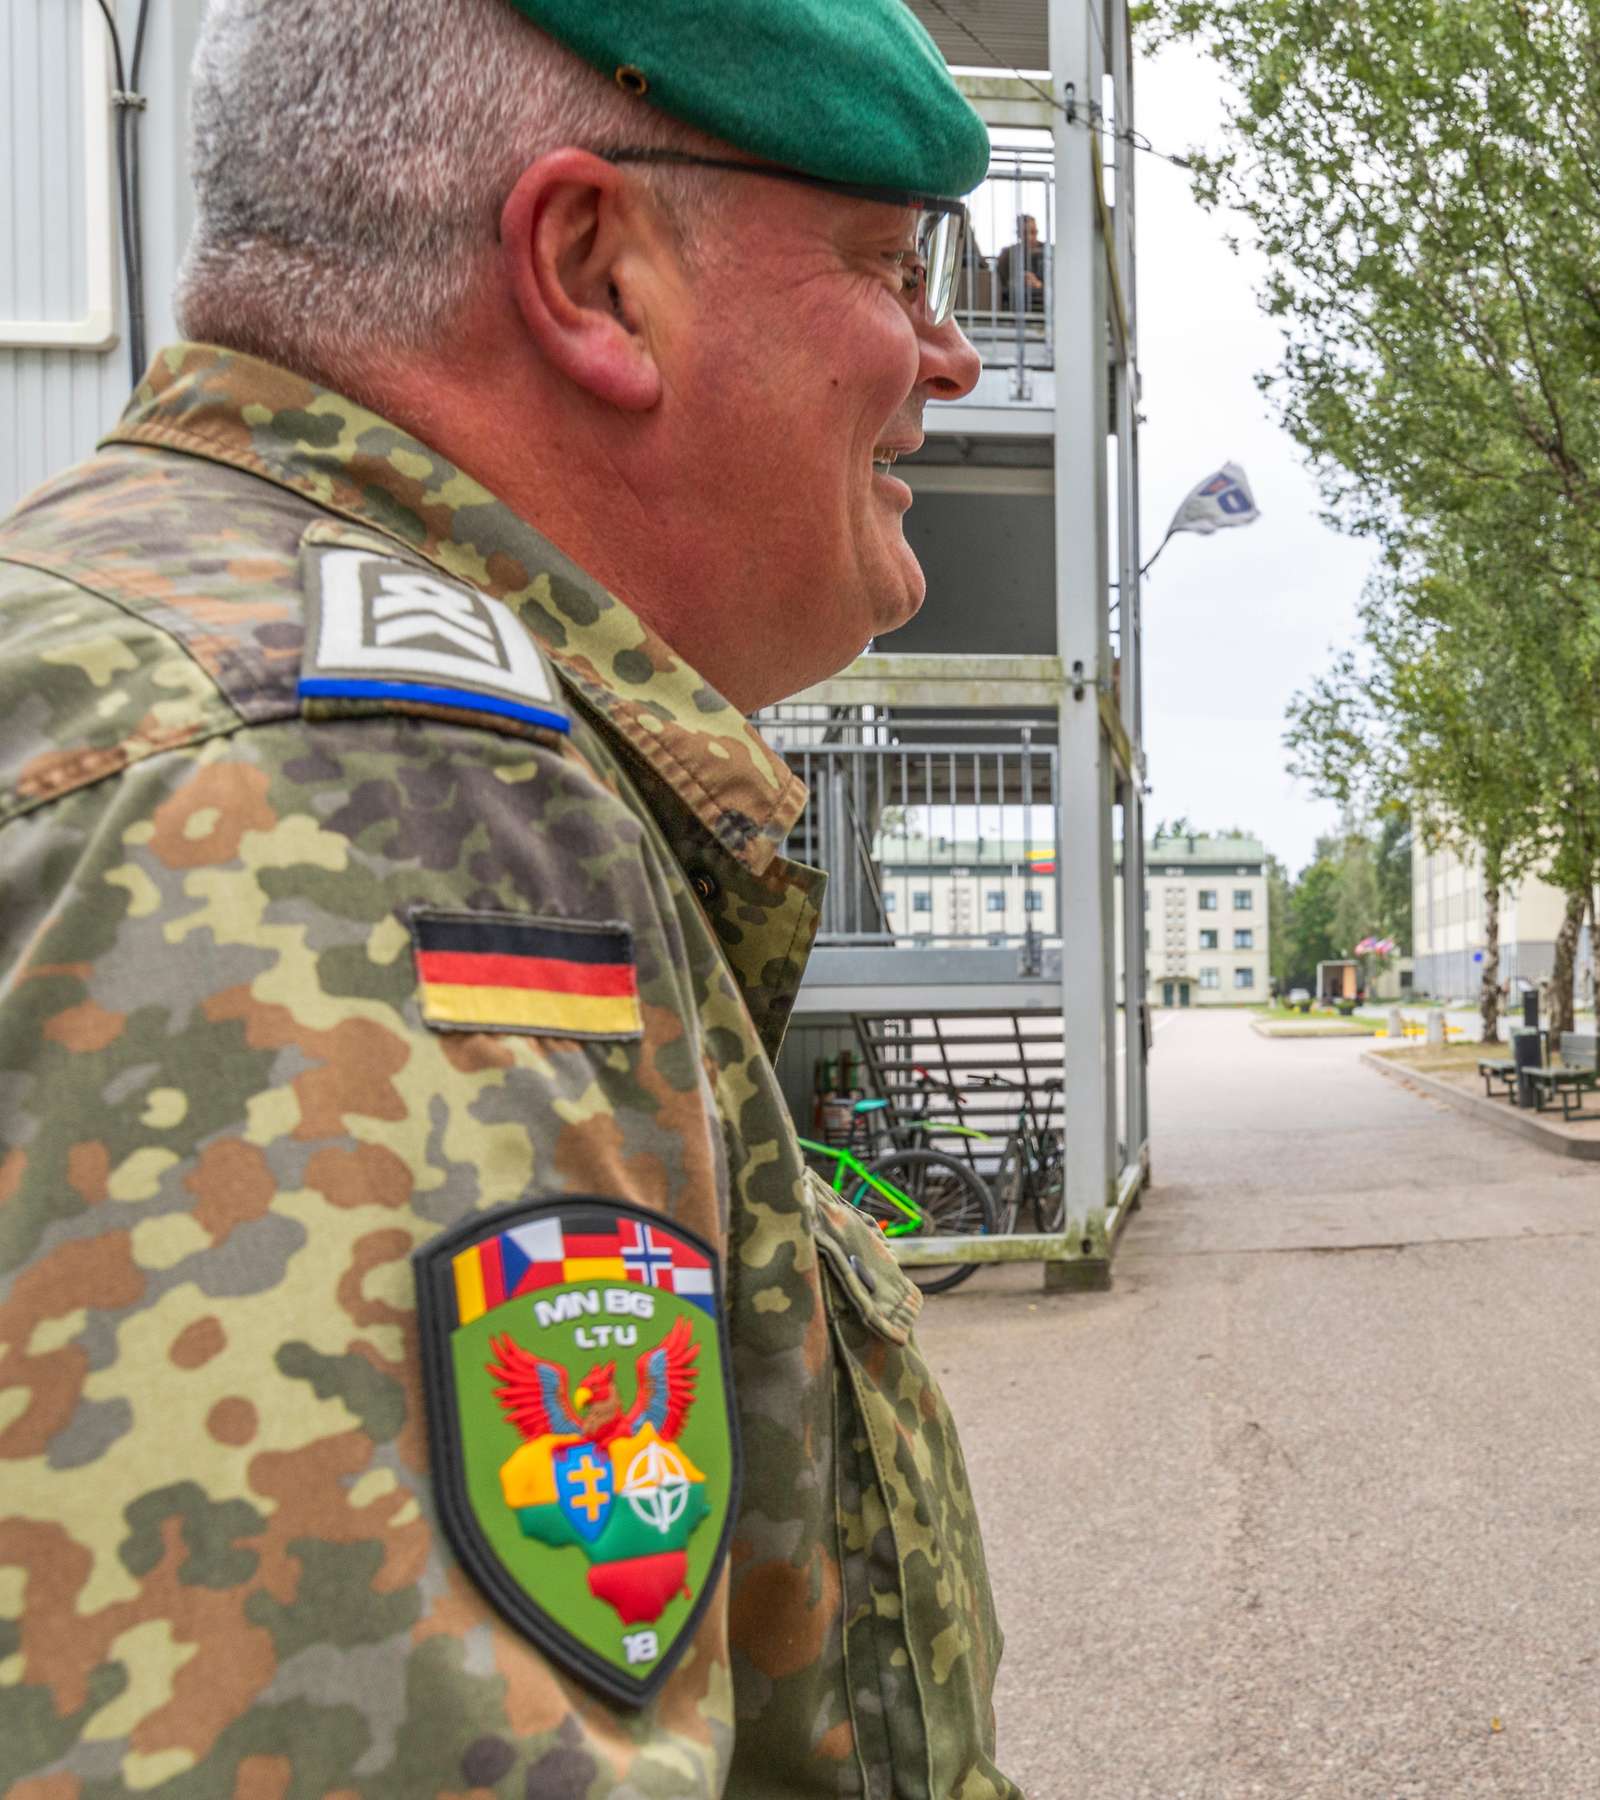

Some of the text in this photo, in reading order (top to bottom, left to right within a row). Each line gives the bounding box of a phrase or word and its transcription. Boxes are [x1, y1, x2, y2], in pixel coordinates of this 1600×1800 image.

[534, 1288, 655, 1328] MN BG
[575, 1325, 637, 1349] LTU
[622, 1631, 658, 1664] 18
